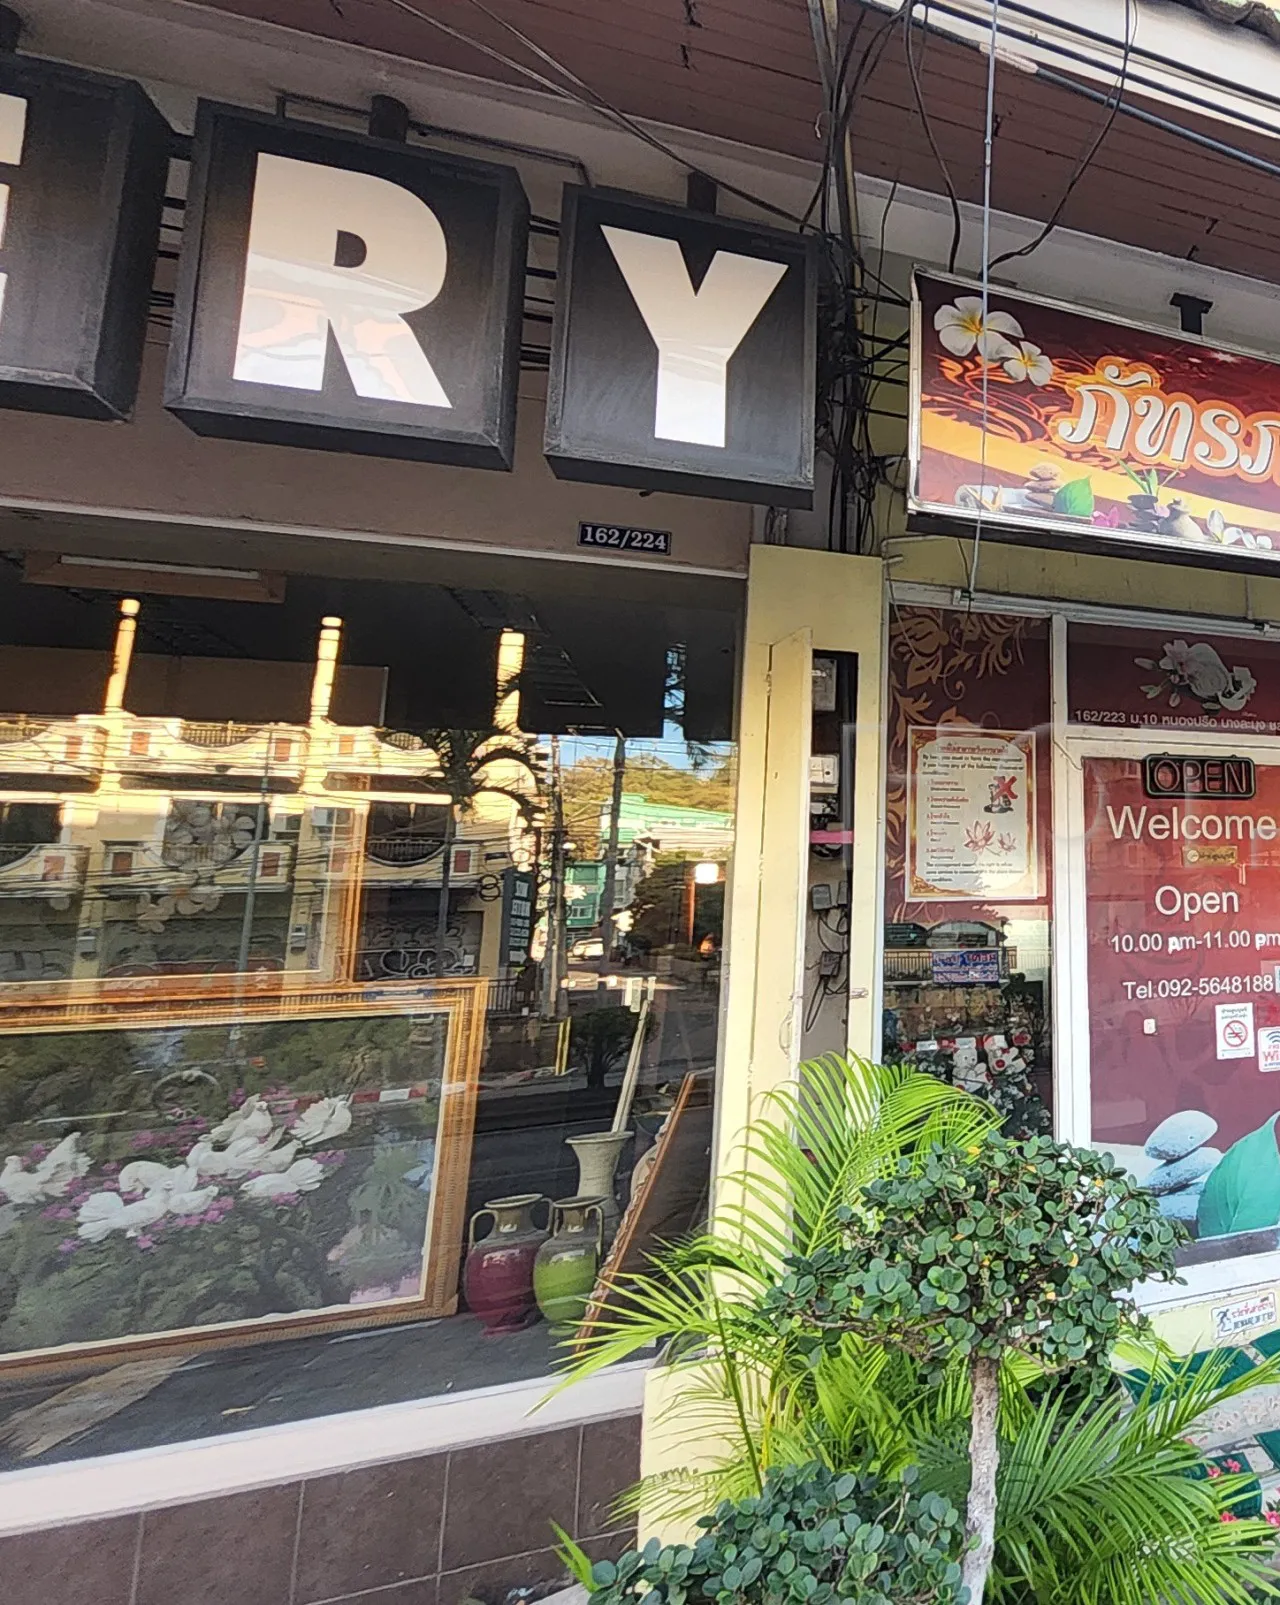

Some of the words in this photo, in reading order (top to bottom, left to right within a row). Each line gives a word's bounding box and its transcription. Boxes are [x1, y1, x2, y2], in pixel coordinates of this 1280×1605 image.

[0, 92, 788, 448] RY
[584, 526, 666, 549] 162/224
[1075, 711, 1126, 724] 162/223
[1154, 760, 1247, 793] OPEN
[1107, 805, 1277, 840] Welcome
[1155, 885, 1239, 921] Open
[1111, 934, 1162, 953] 10.00
[1123, 975, 1274, 1000] Tel.092-5648188
